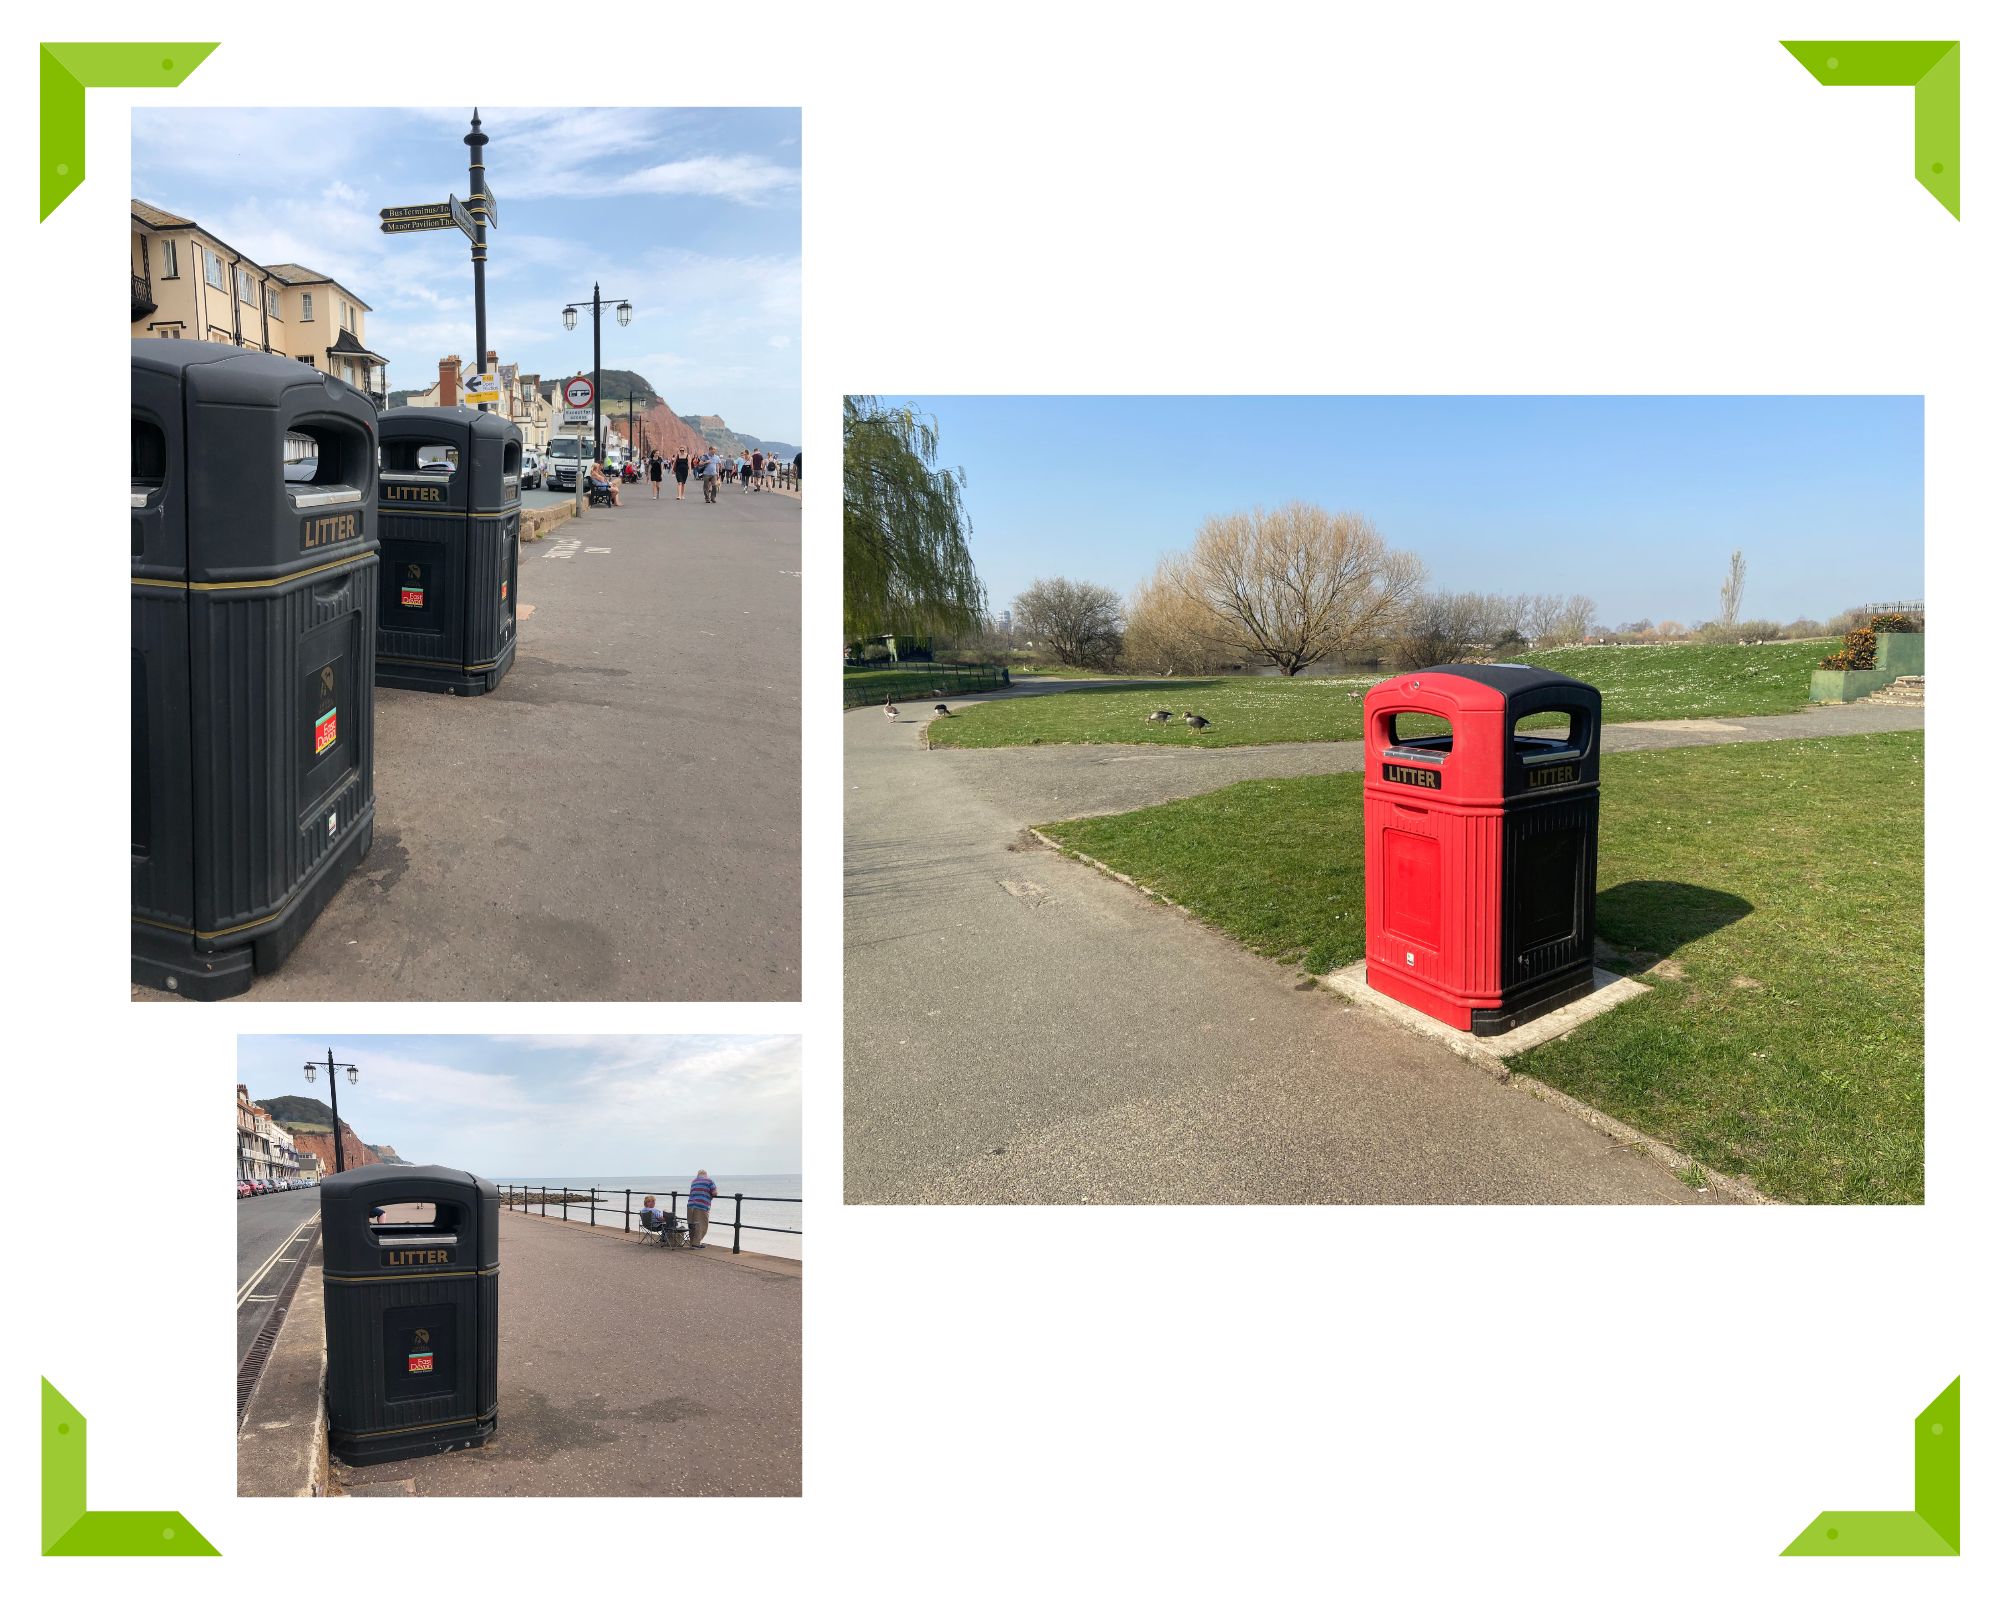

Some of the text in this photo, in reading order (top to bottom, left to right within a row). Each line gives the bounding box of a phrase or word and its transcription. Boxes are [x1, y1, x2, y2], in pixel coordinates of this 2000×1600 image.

[389, 209, 403, 217] Bus
[387, 223, 410, 231] Manor
[412, 219, 440, 229] Pavilion
[387, 486, 441, 502] LITTER
[305, 514, 356, 548] LITTER
[323, 720, 336, 736] East
[317, 728, 336, 751] Devon
[1388, 765, 1436, 788] LITTER
[1529, 765, 1574, 788] LITTER
[389, 1249, 449, 1265] LITTER
